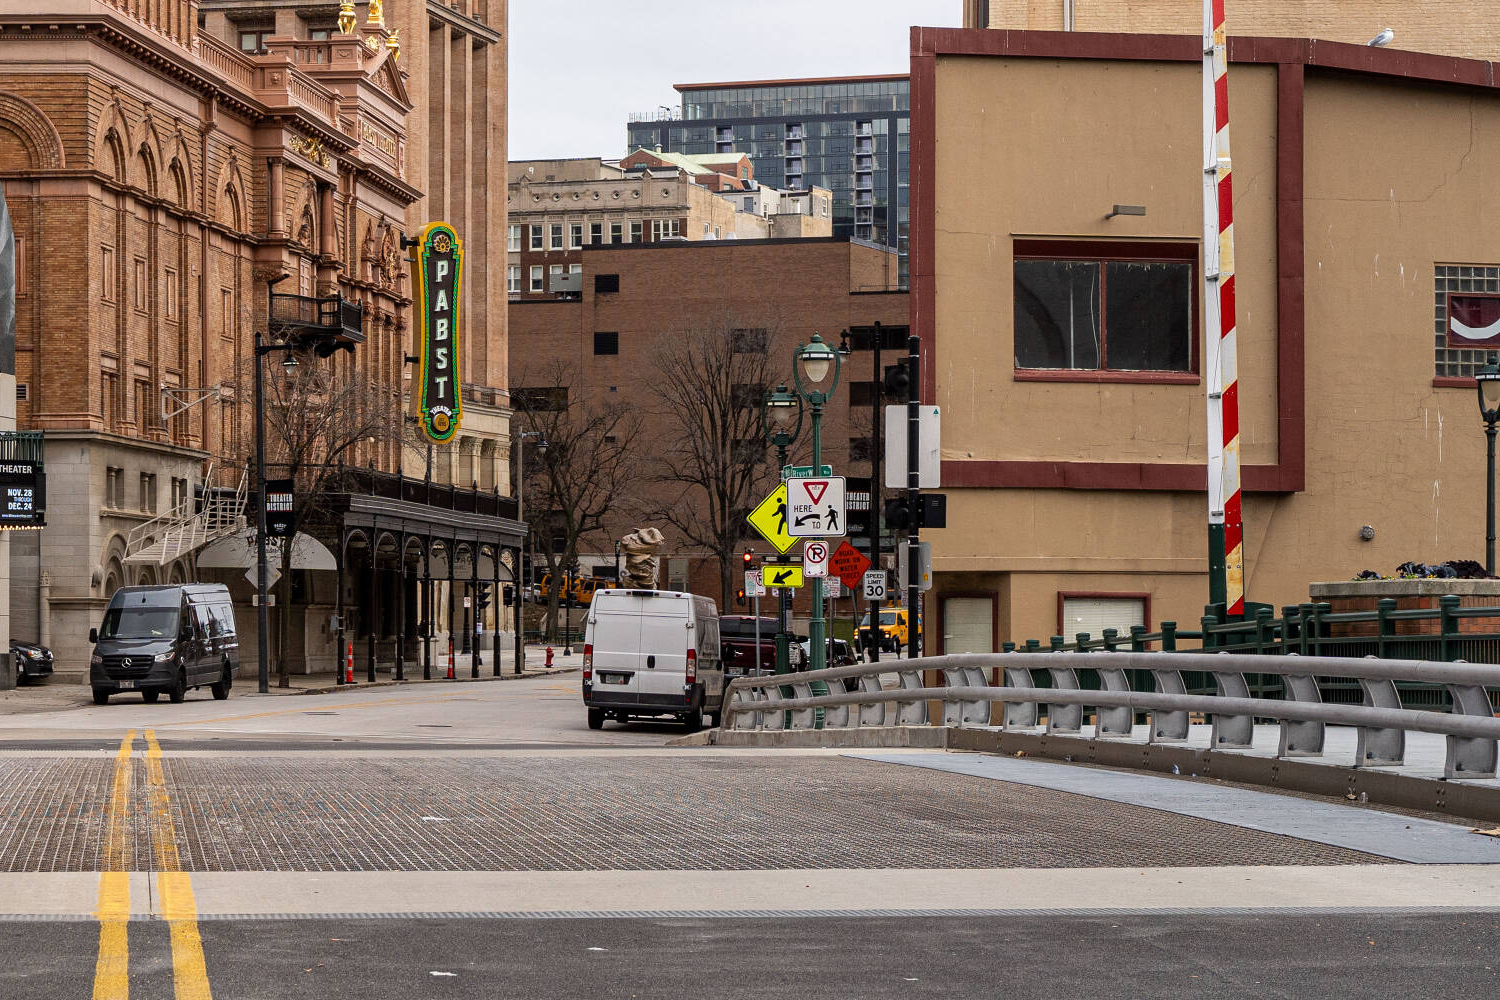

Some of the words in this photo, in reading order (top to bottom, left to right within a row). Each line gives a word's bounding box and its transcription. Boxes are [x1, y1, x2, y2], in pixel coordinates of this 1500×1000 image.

[434, 259, 450, 399] PABST
[429, 405, 453, 417] THEATER
[7, 488, 23, 497] NOV.
[23, 488, 33, 497] 28
[270, 493, 293, 502] THEATER
[8, 502, 23, 510] DEC.
[23, 502, 33, 510] 24
[266, 502, 293, 511] DISTRICT
[793, 505, 813, 513] HERE
[846, 501, 870, 510] ISTRICT
[812, 521, 821, 529] TO
[866, 585, 884, 596] 30
